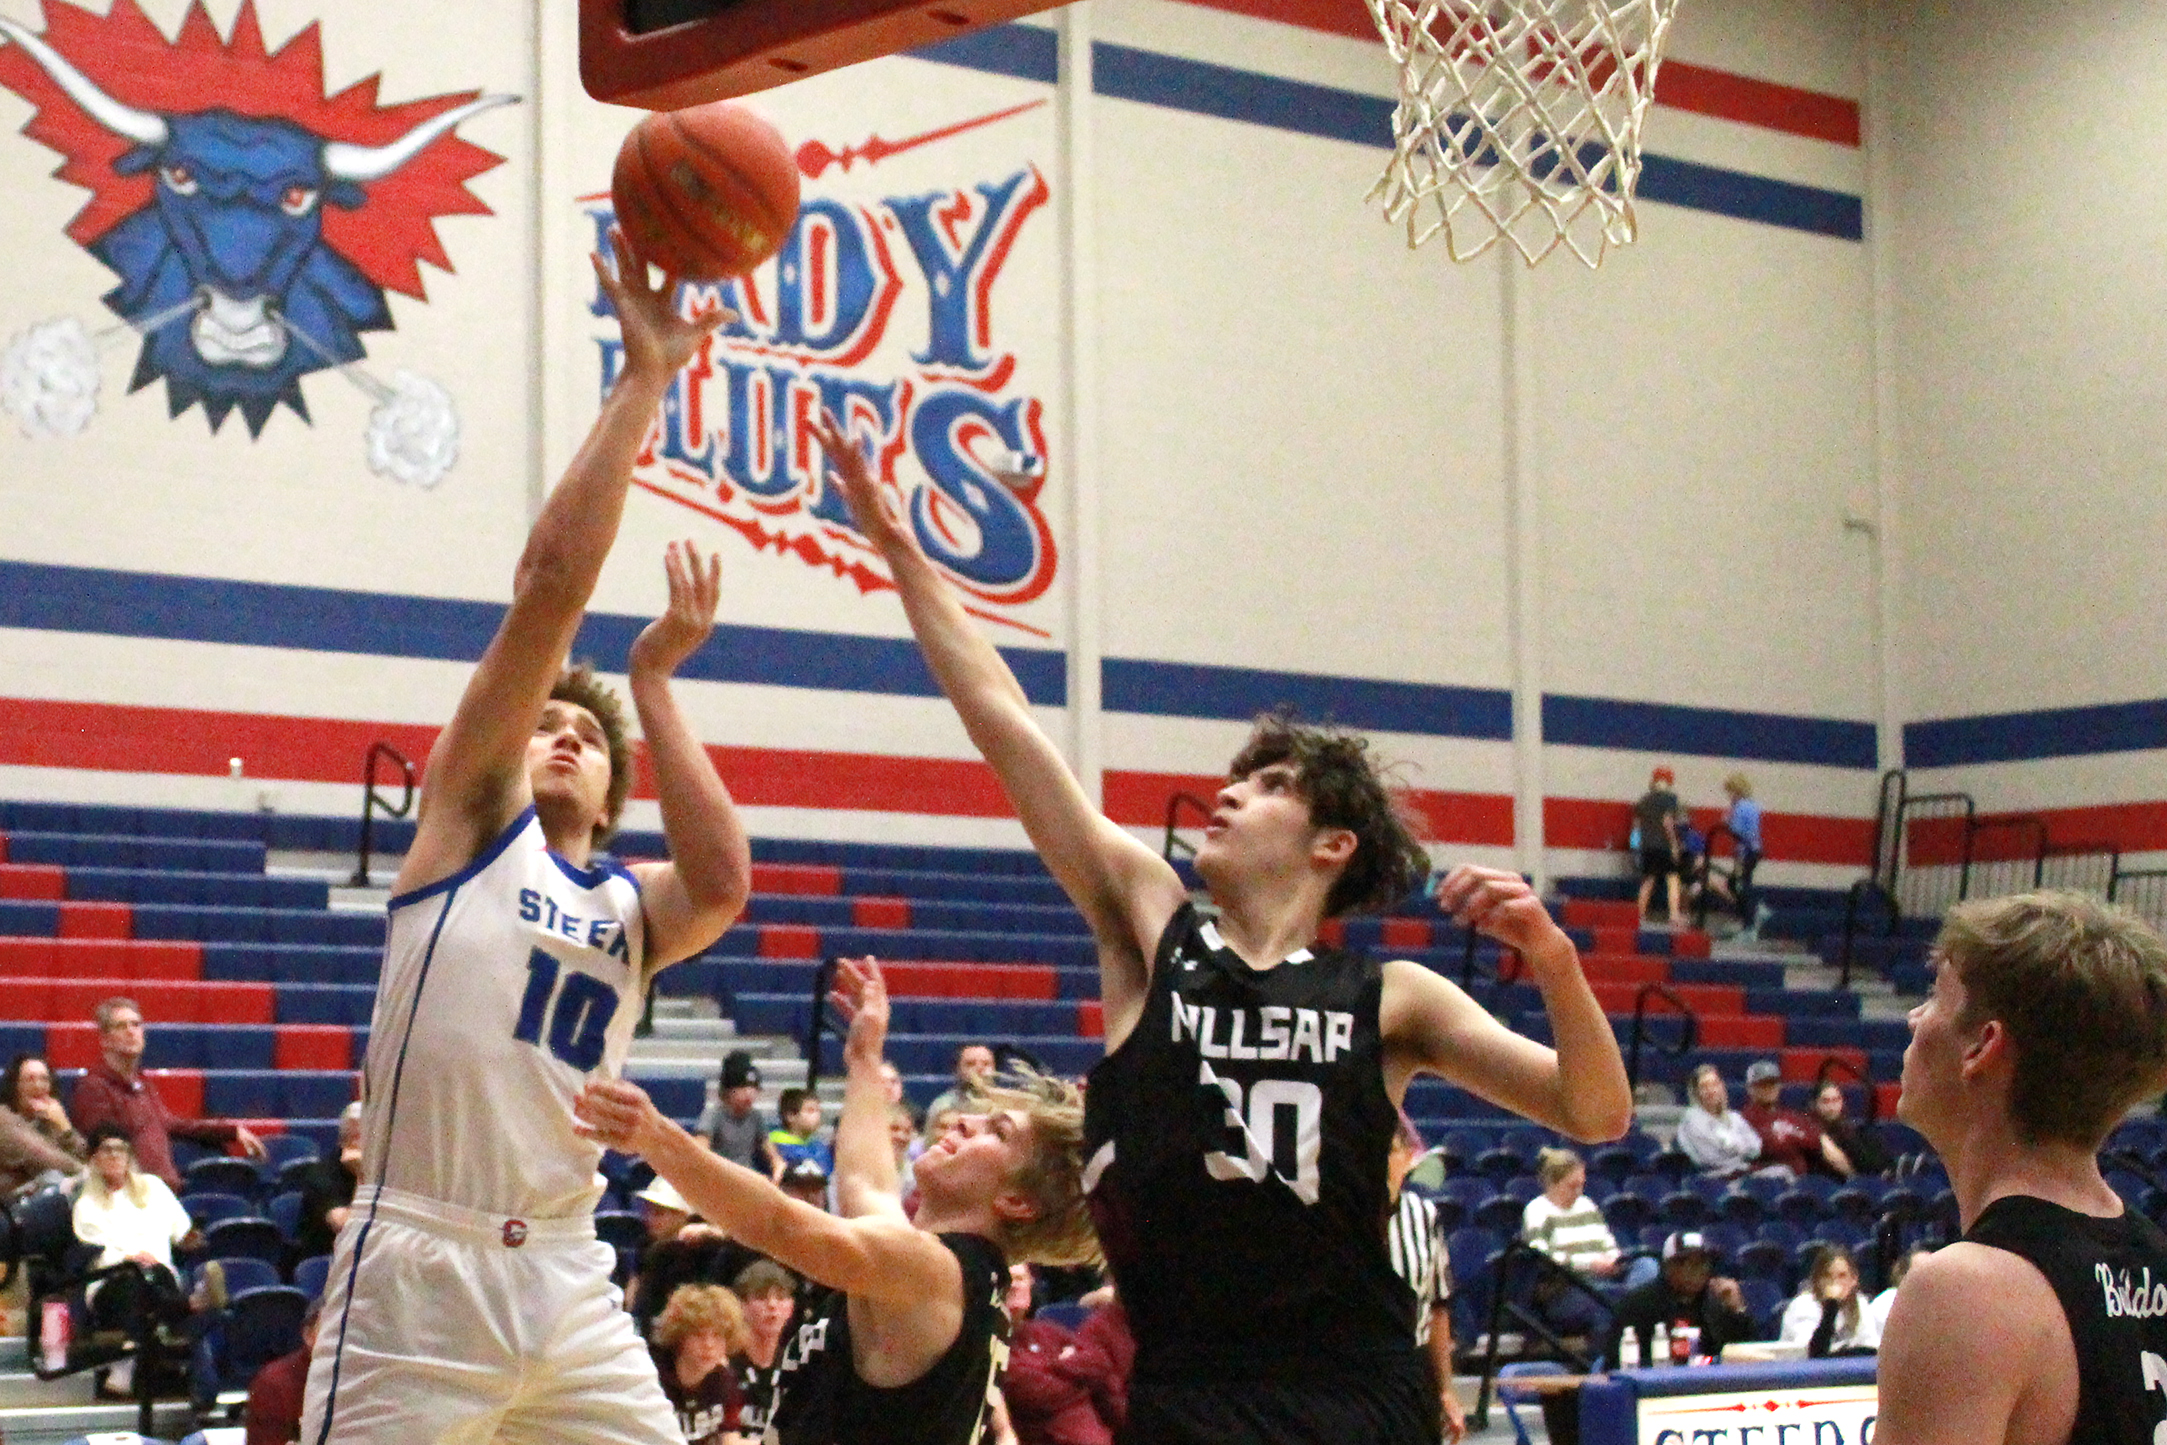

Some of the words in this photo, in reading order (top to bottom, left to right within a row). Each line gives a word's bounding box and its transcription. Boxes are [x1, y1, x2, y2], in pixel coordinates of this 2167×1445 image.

[584, 160, 1050, 392] DY
[597, 336, 1058, 605] LUES
[513, 944, 620, 1073] 10
[1199, 1059, 1323, 1206] 30
